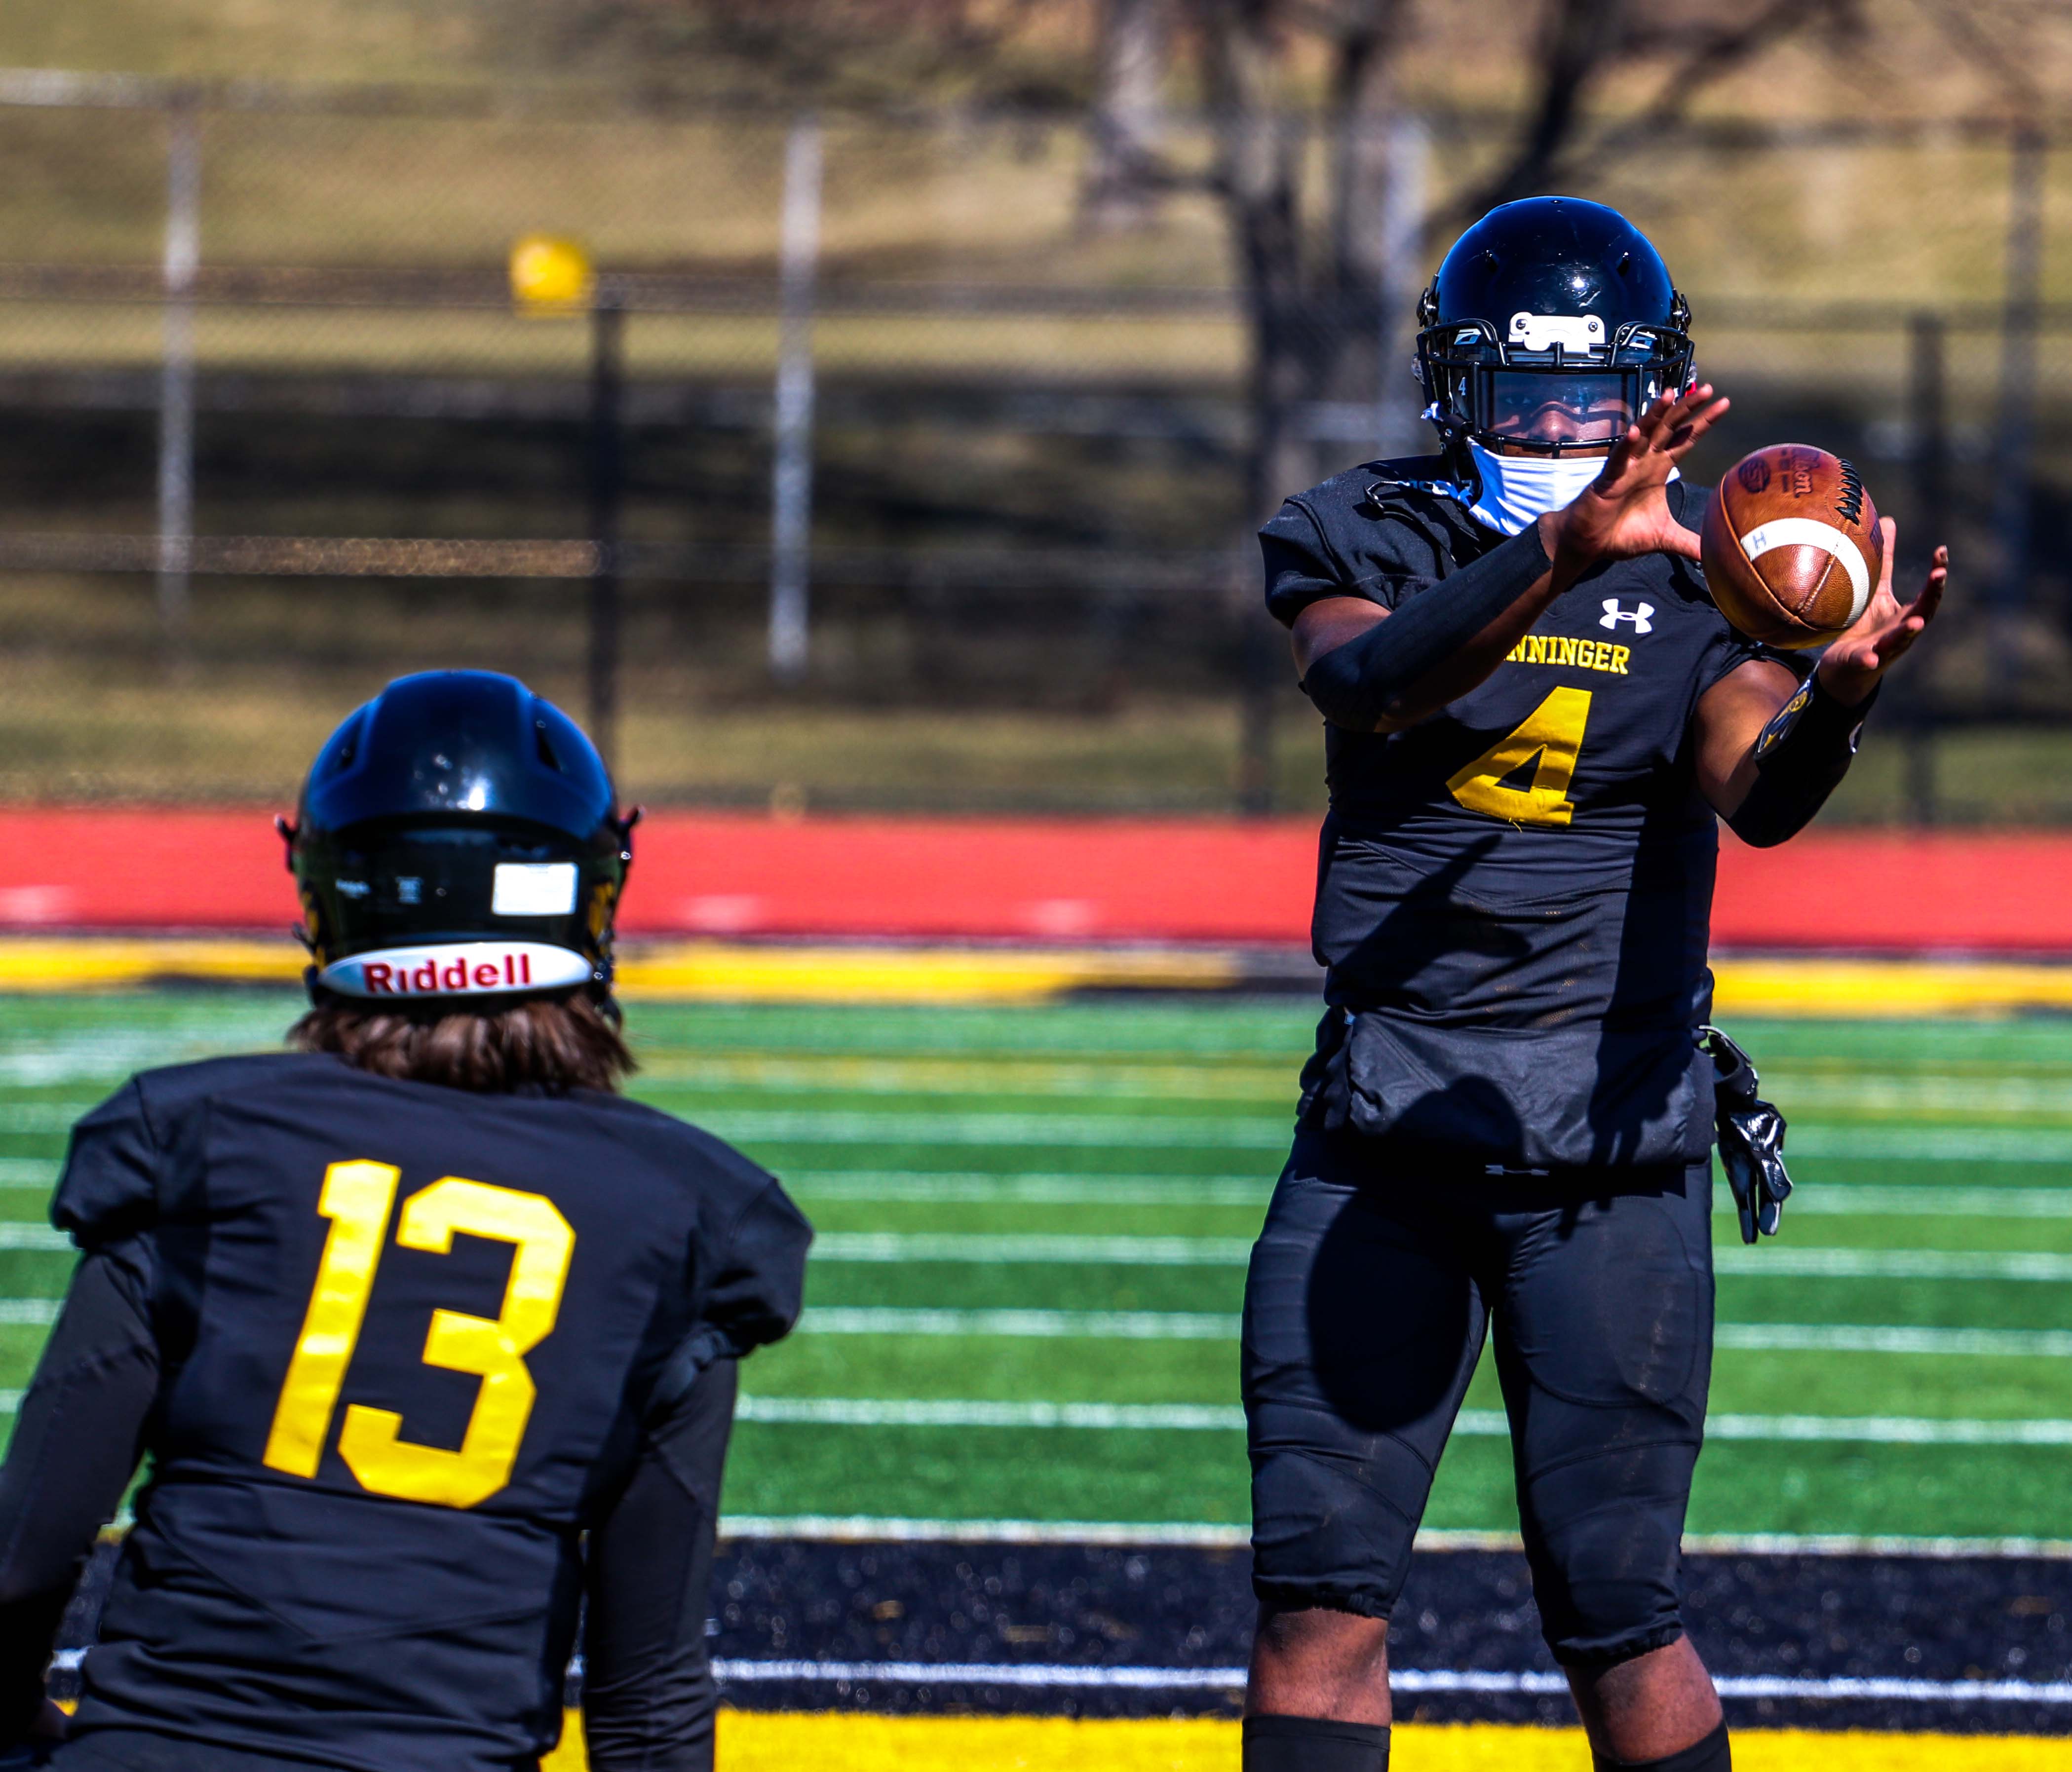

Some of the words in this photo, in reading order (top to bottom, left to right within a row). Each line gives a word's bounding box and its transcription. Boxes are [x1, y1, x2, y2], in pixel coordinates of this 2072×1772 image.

[1458, 377, 1466, 396] 4
[1504, 635, 1631, 675] NNINGER
[1446, 685, 1593, 826] 4
[363, 953, 530, 993] Riddell
[262, 1158, 576, 1510] 13
